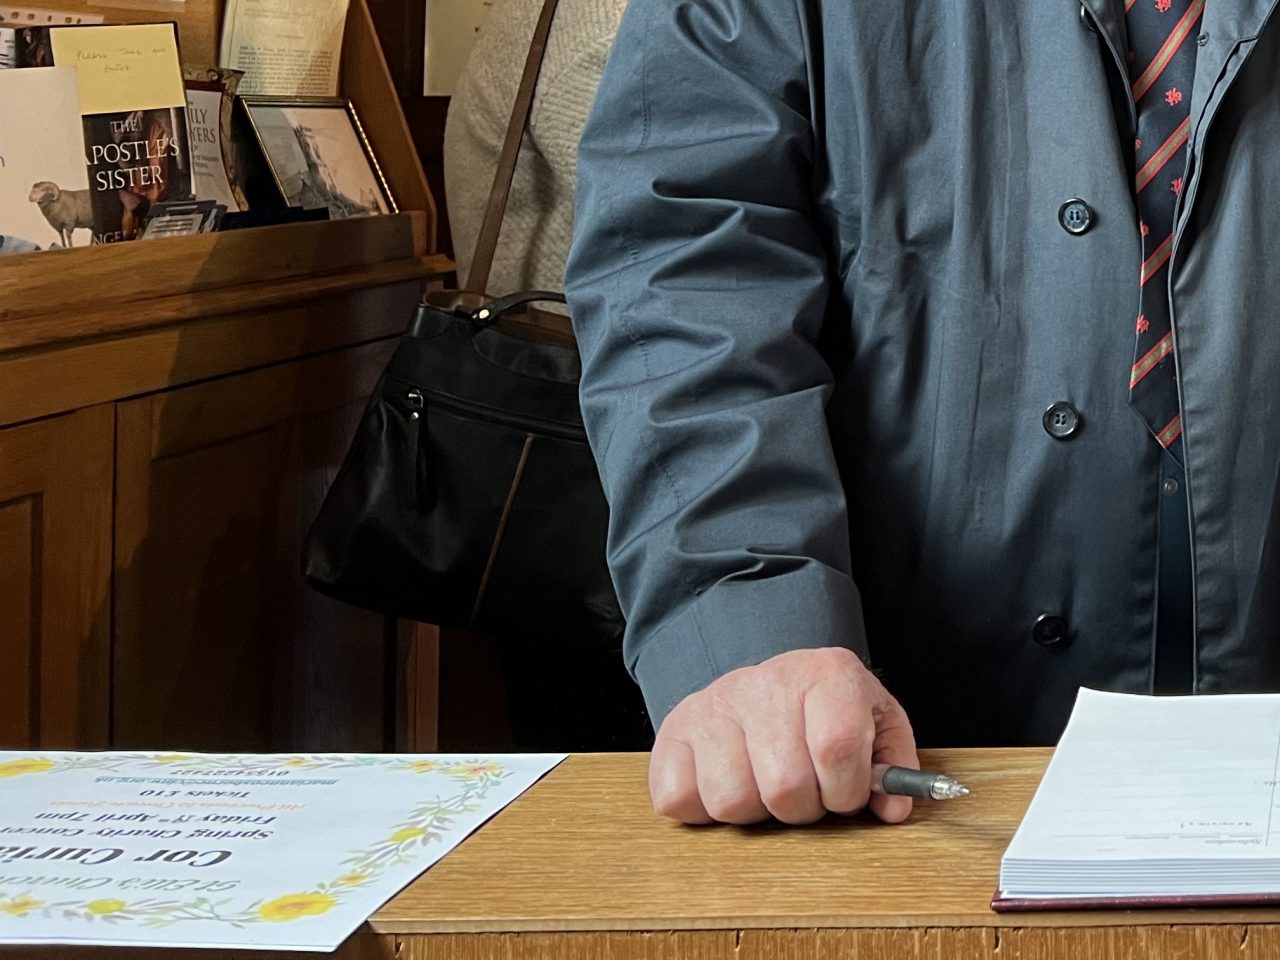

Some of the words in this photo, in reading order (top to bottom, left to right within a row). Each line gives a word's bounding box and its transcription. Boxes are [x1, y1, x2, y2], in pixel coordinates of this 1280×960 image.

[110, 120, 138, 134] THE
[86, 137, 180, 166] POSTLE'S
[96, 165, 163, 191] SISTER
[35, 812, 90, 822] 7pm
[94, 813, 159, 823] April
[202, 813, 277, 825] Friday
[88, 827, 182, 839] Charity
[186, 828, 275, 840] Spring
[134, 850, 232, 867] Cor
